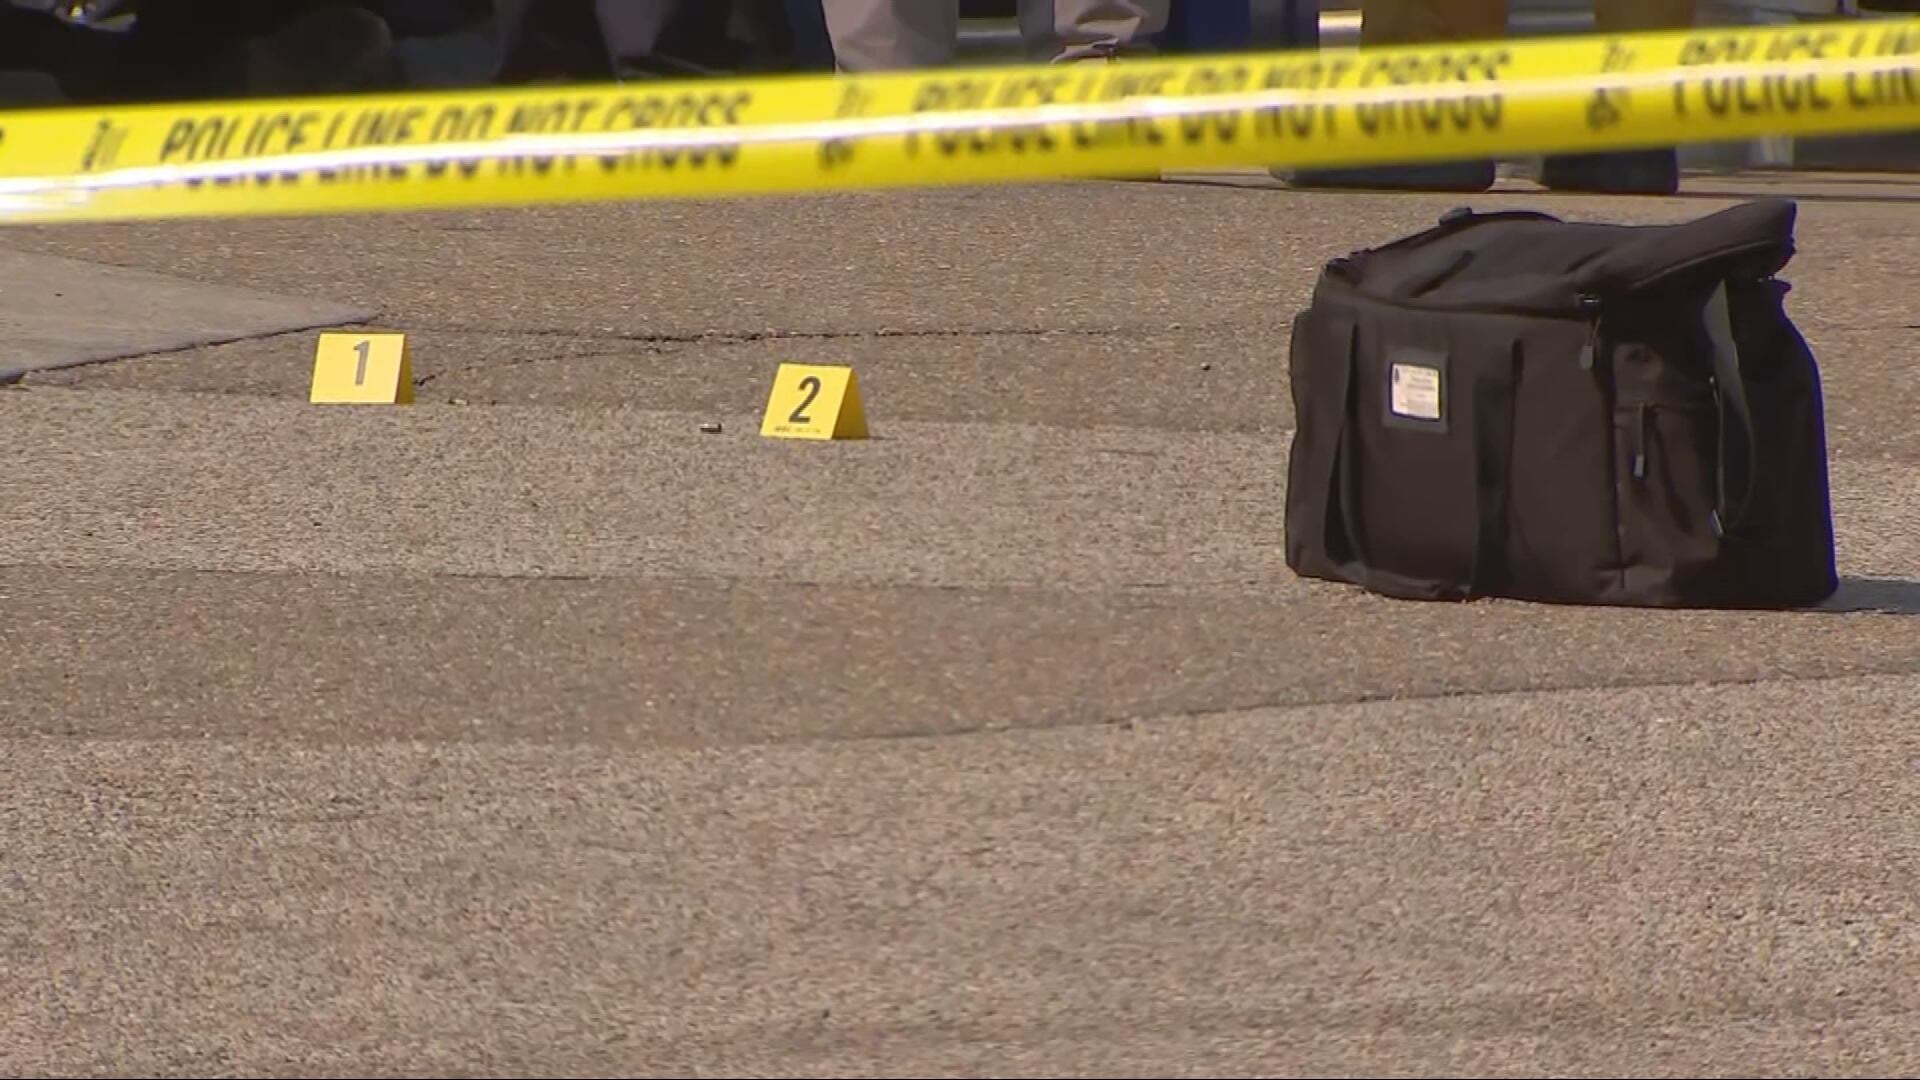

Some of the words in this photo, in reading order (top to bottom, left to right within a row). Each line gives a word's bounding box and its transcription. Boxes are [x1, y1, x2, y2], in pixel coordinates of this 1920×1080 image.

[905, 76, 1068, 158] POLICE
[1254, 60, 1354, 137] NOT
[1355, 51, 1512, 138] CROSS
[1674, 32, 1838, 116] POLICE
[158, 112, 320, 188] POLICE
[318, 106, 424, 184] LINE
[426, 103, 498, 178] DO
[497, 96, 599, 174] NOT
[599, 91, 752, 170] CROSS
[353, 340, 370, 386] 1
[788, 376, 822, 423] 2
